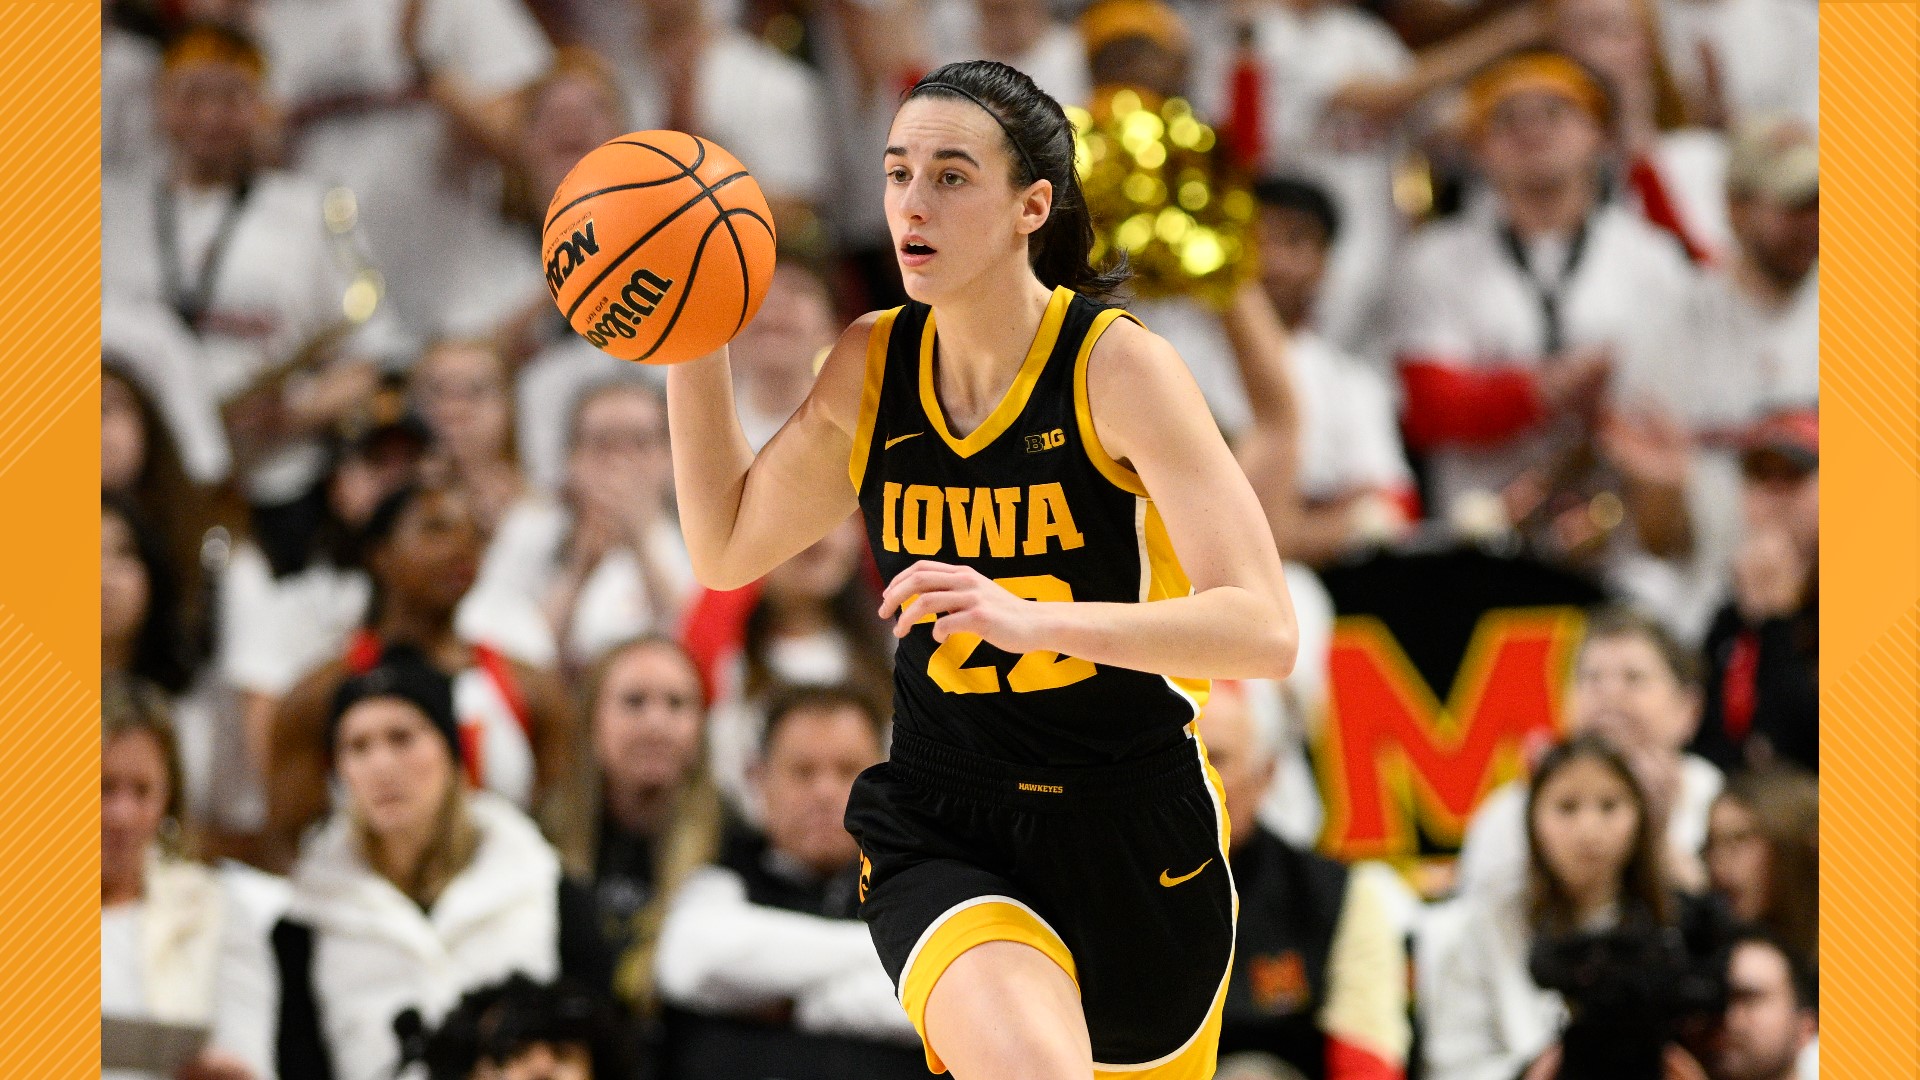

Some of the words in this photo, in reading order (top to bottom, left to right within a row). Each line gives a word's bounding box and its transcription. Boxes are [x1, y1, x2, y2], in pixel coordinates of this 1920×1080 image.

[585, 311, 597, 325] NXT
[595, 296, 609, 312] EVO
[882, 481, 1085, 558] IOWA
[900, 573, 1098, 695] 22
[1312, 605, 1587, 865] M
[1018, 782, 1064, 794] HAWKEYES
